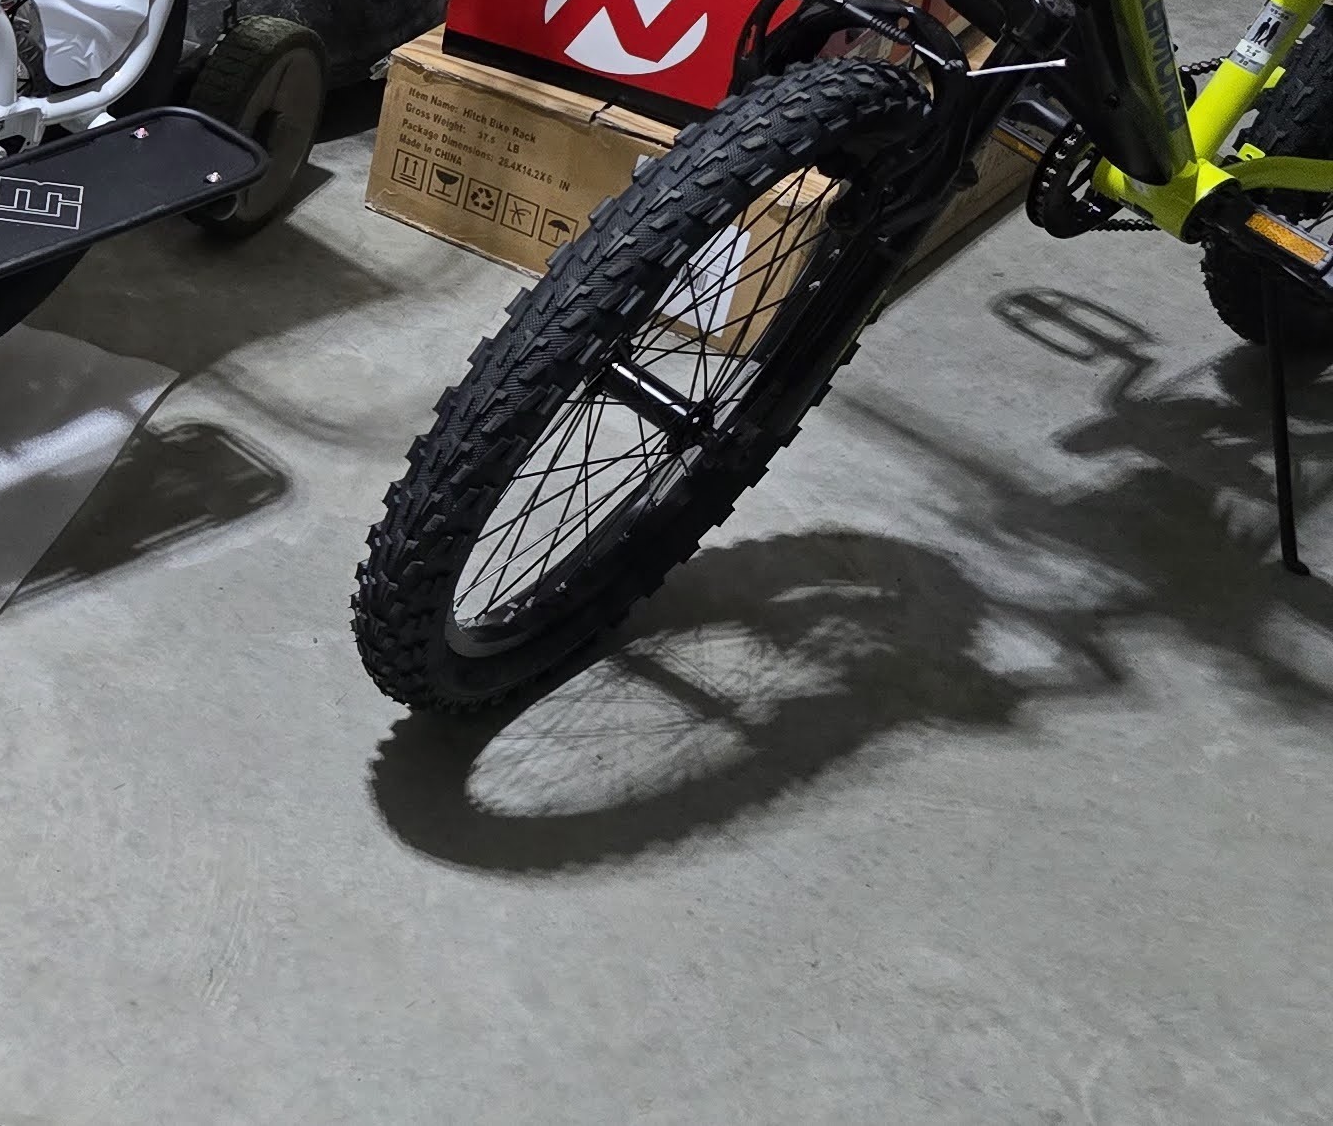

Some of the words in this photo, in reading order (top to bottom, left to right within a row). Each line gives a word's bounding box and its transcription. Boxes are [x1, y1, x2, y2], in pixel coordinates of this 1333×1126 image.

[405, 103, 431, 120] Gross
[433, 114, 466, 134] Weight:
[507, 142, 520, 154] LB
[408, 87, 429, 102] Item
[431, 95, 459, 113] Name:
[463, 107, 487, 124] Hitch
[489, 117, 510, 134] Bike
[513, 126, 536, 144] Rack
[399, 134, 421, 150] Made
[435, 147, 462, 166] CHINA
[402, 118, 439, 143] Package
[441, 132, 493, 162] Dimensions:
